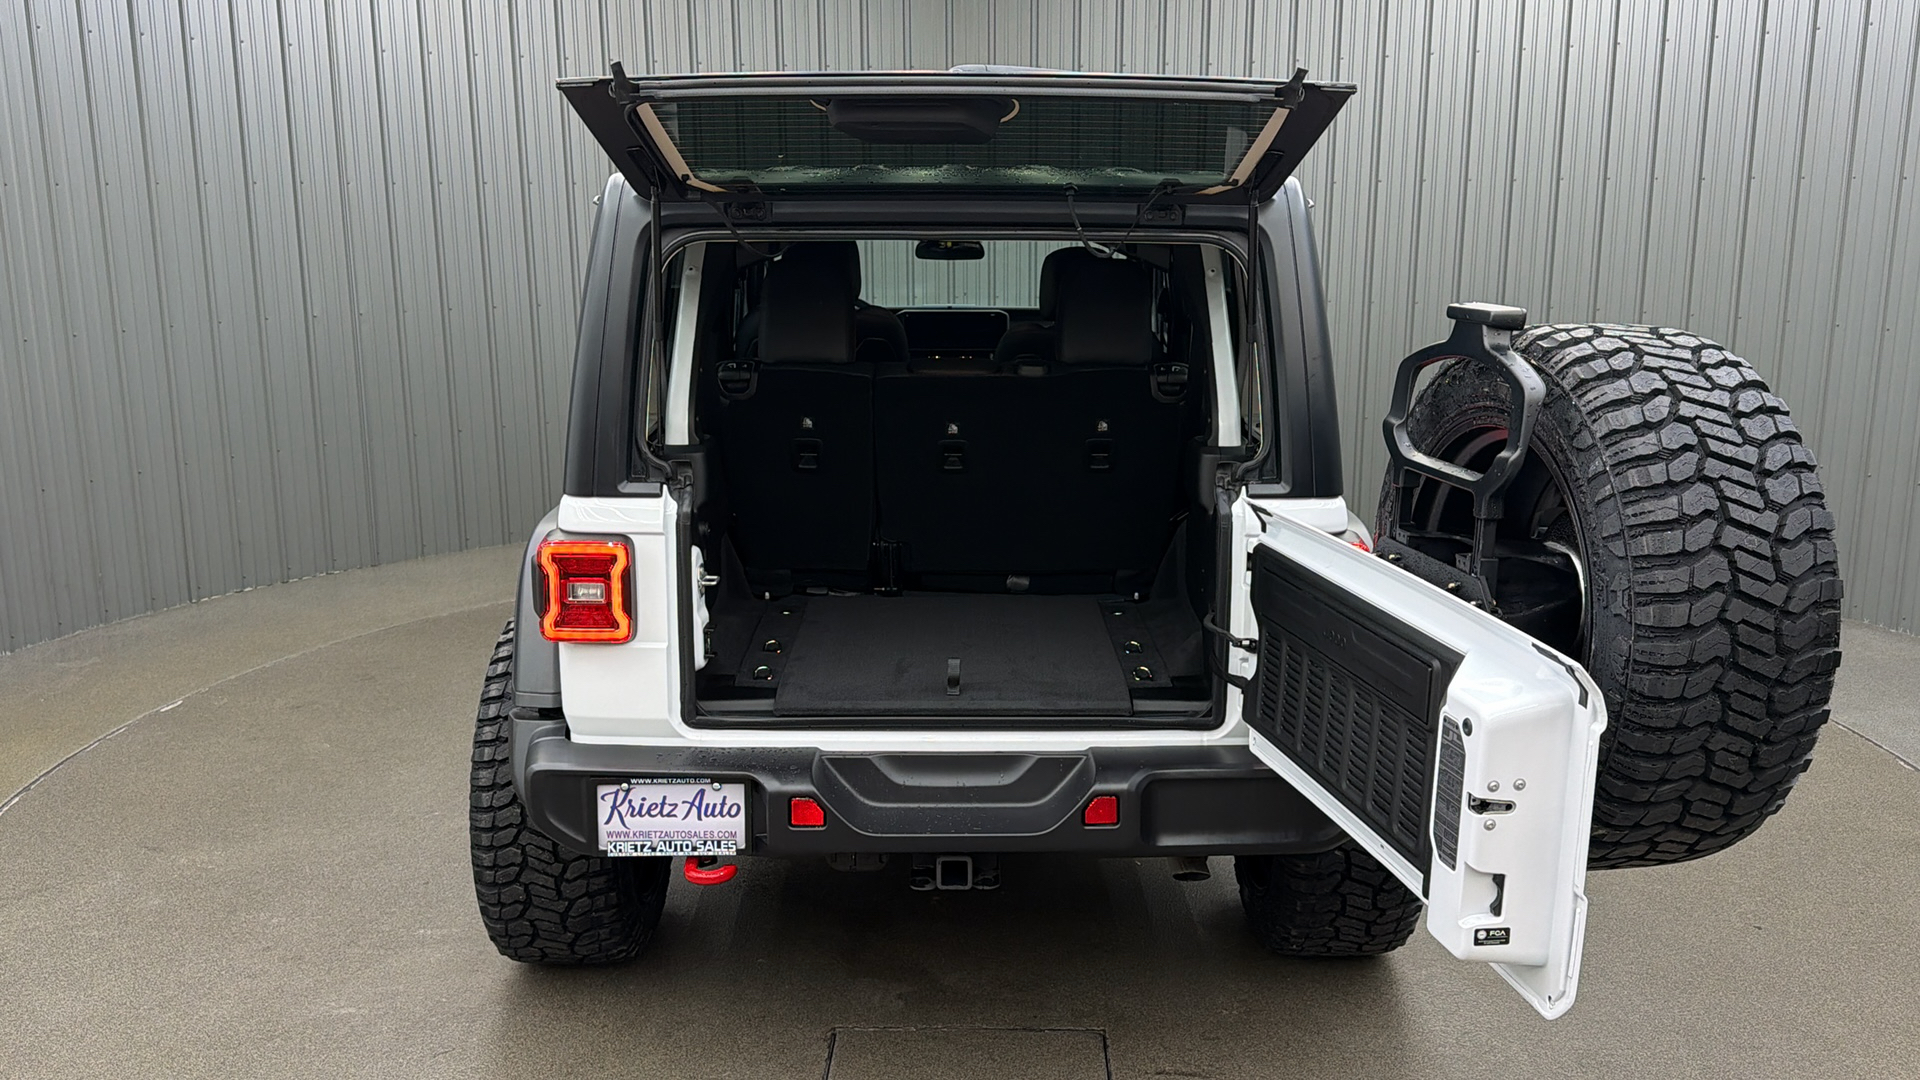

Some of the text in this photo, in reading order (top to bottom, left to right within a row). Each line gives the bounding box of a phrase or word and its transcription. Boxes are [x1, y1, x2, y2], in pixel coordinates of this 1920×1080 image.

[600, 786, 742, 830] Krietz Auto
[606, 830, 738, 839] WWW.KRIETZAUTOSALES.COM
[607, 840, 737, 853] KRIETZ AUTO SALES
